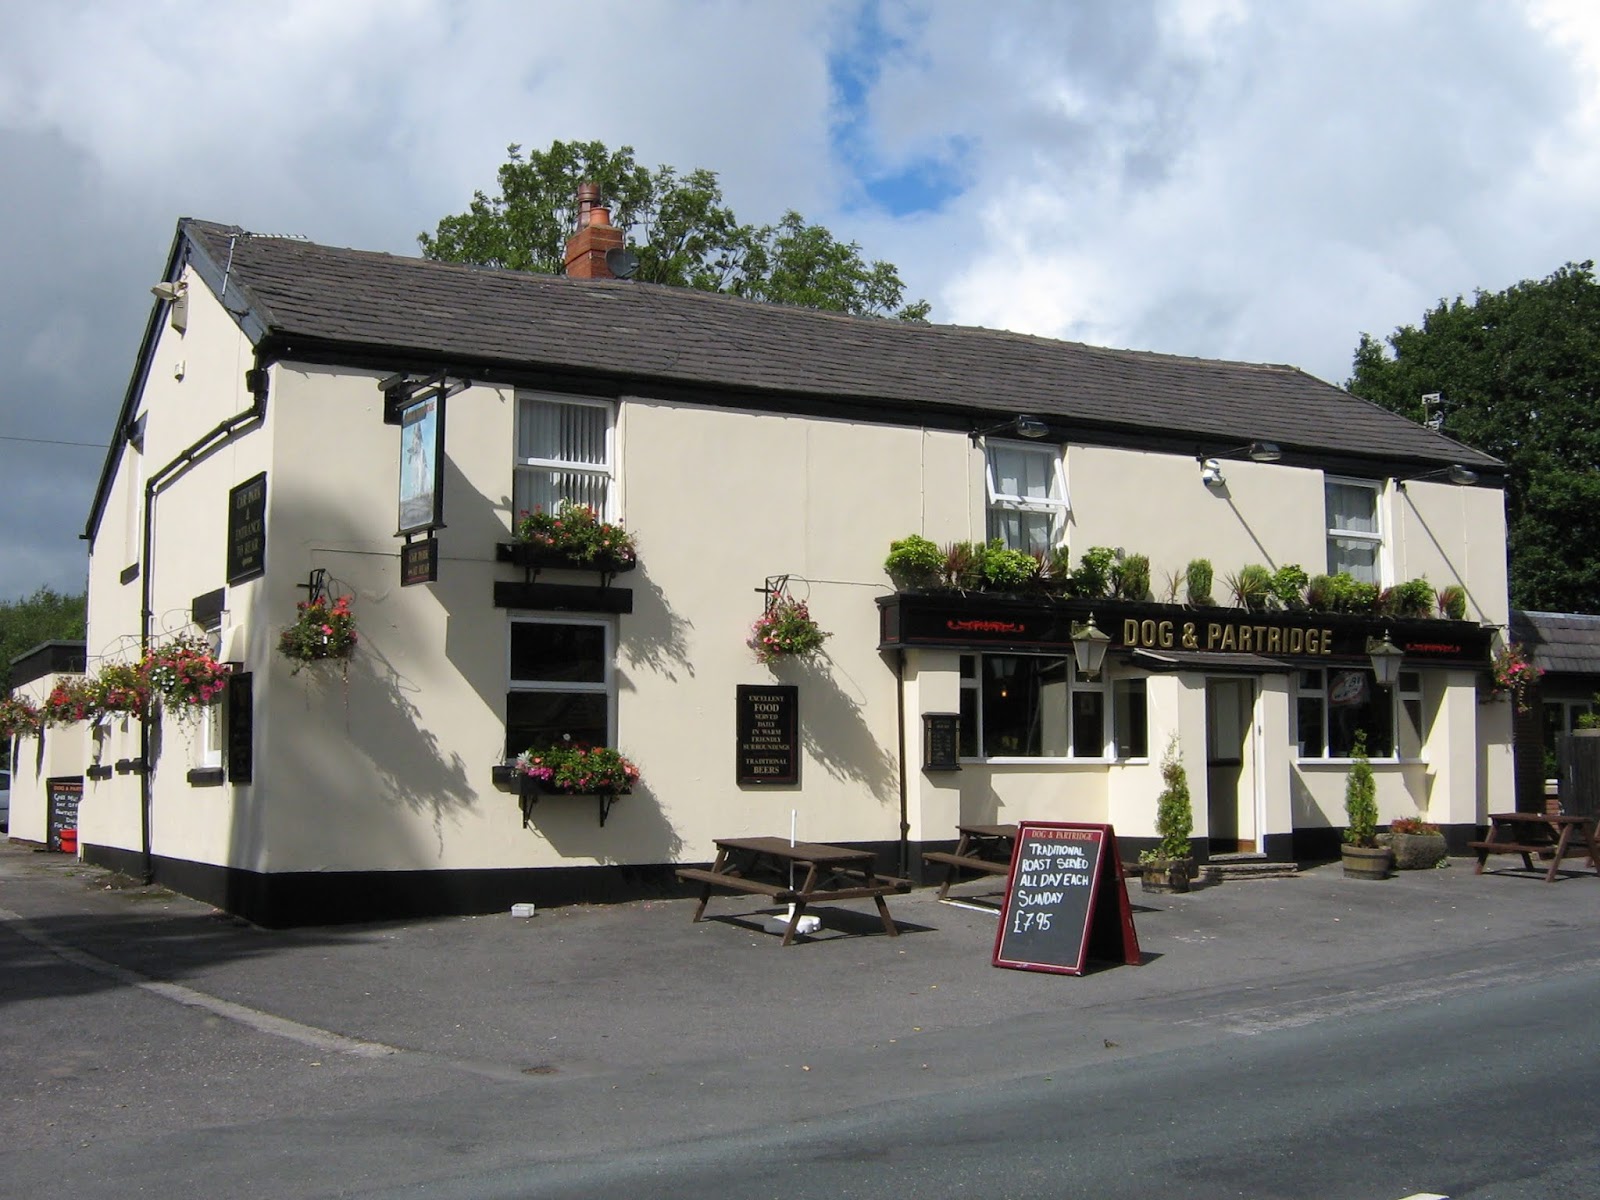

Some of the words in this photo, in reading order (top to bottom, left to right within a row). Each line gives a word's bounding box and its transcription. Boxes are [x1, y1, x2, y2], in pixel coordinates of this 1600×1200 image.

[1123, 618, 1174, 648] DOG
[1182, 622, 1199, 649] &
[1207, 623, 1333, 655] PARTRIDGE
[754, 703, 779, 712] FOOD
[753, 766, 780, 774] BEERS
[1031, 830, 1046, 838] DOG
[1056, 832, 1093, 840] PARTRIDGE
[1029, 843, 1085, 857] TRADITIONAL
[1022, 858, 1051, 872] ROAST
[1056, 857, 1089, 870] SERVED
[1020, 874, 1037, 887] ALL
[1040, 873, 1063, 888] DAY
[1063, 873, 1089, 886] EACH
[1018, 890, 1064, 907] SUNDAY
